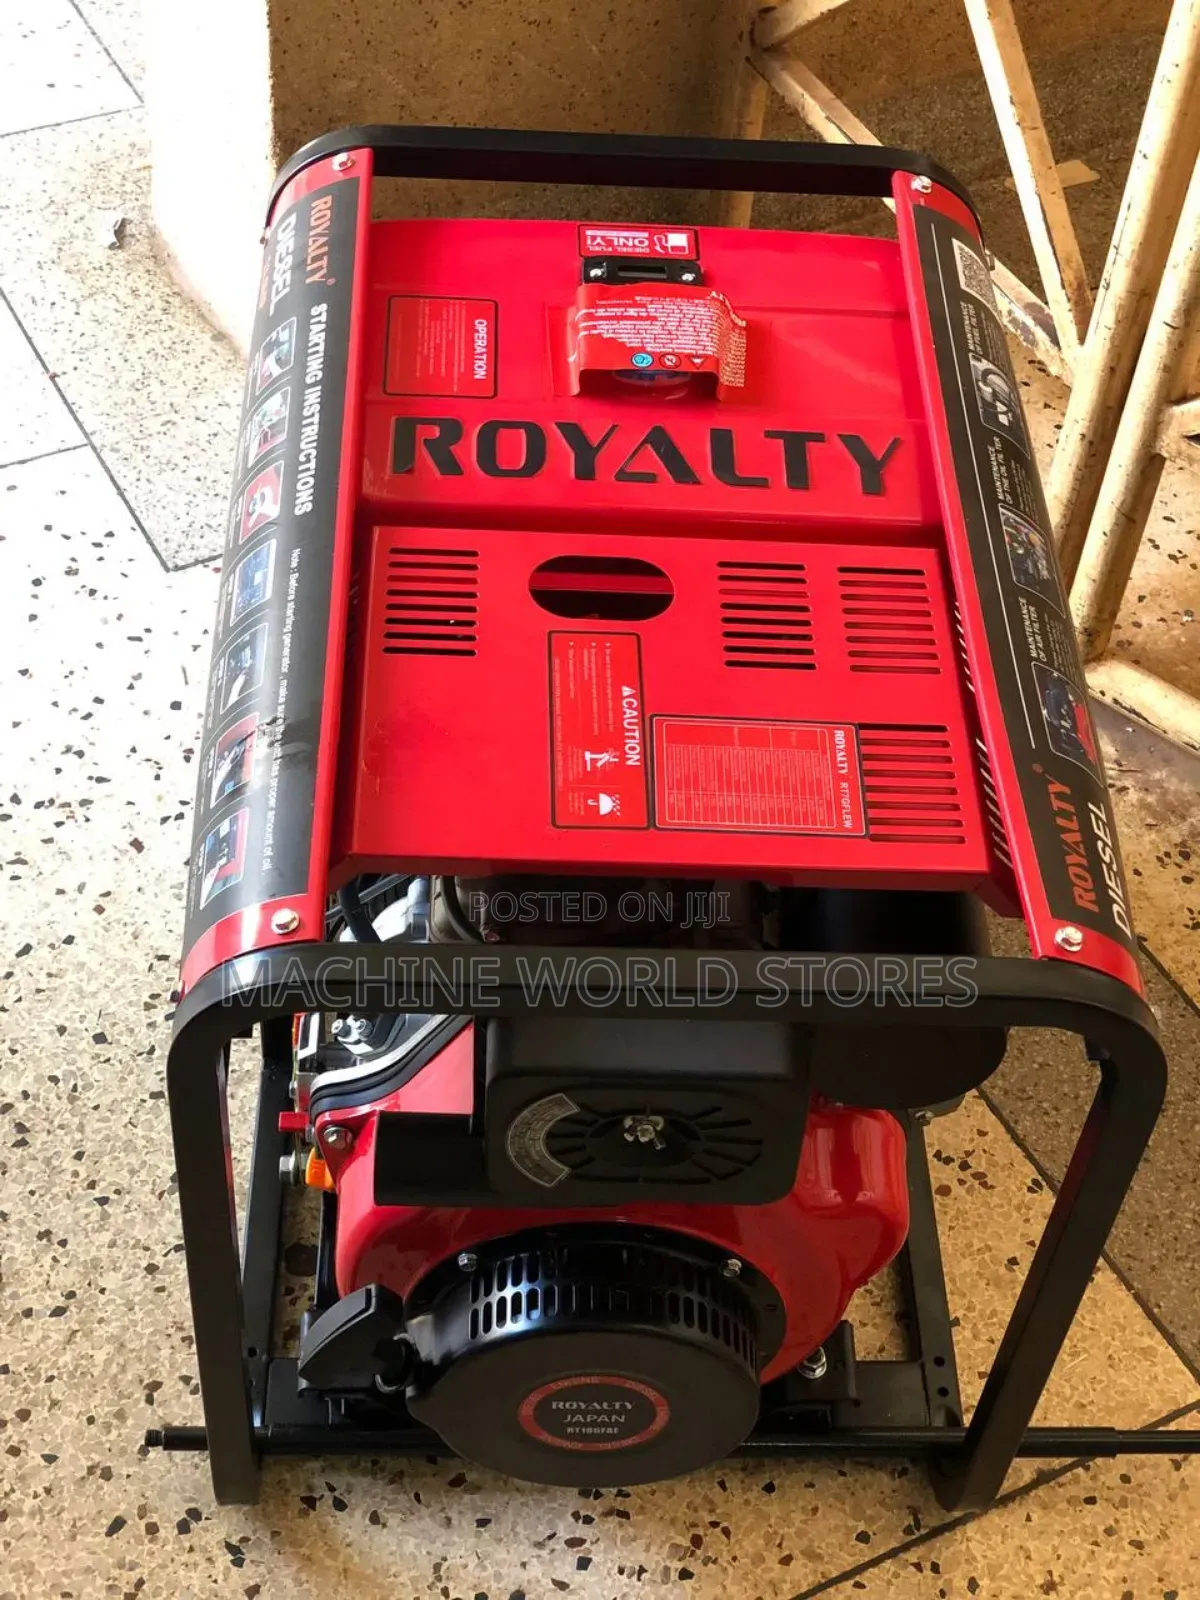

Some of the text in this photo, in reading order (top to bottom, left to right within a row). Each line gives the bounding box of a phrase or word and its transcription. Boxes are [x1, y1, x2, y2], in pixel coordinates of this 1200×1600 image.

[305, 195, 332, 285] ROYALTY
[586, 235, 650, 247] ONLY!
[269, 212, 297, 316] DIESEL
[960, 300, 976, 352] MAINTENANCE
[972, 328, 981, 345] FUEL
[473, 318, 488, 380] OPERATION
[975, 344, 984, 355] OF
[294, 303, 328, 517] STARTING INSTRUCTIONS
[389, 416, 904, 495] ROYALTY
[987, 444, 1005, 501] MAINTENANCE
[1002, 477, 1011, 492] THE
[1004, 492, 1013, 504] OF
[288, 572, 299, 601] Before
[283, 601, 296, 632] starting
[1018, 596, 1038, 658] MAINTENANCE
[1035, 634, 1044, 650] AIR
[1039, 649, 1047, 661] OF
[276, 704, 286, 725] sure
[622, 698, 641, 766] CAUTION
[834, 729, 849, 775] ROYALTY
[264, 809, 276, 846] amount
[1044, 773, 1100, 912] ROYALTY
[263, 846, 273, 857] of
[1087, 801, 1132, 940] DIESEL
[552, 1401, 635, 1410] ROYALTY
[564, 1414, 626, 1423] JAPAN
